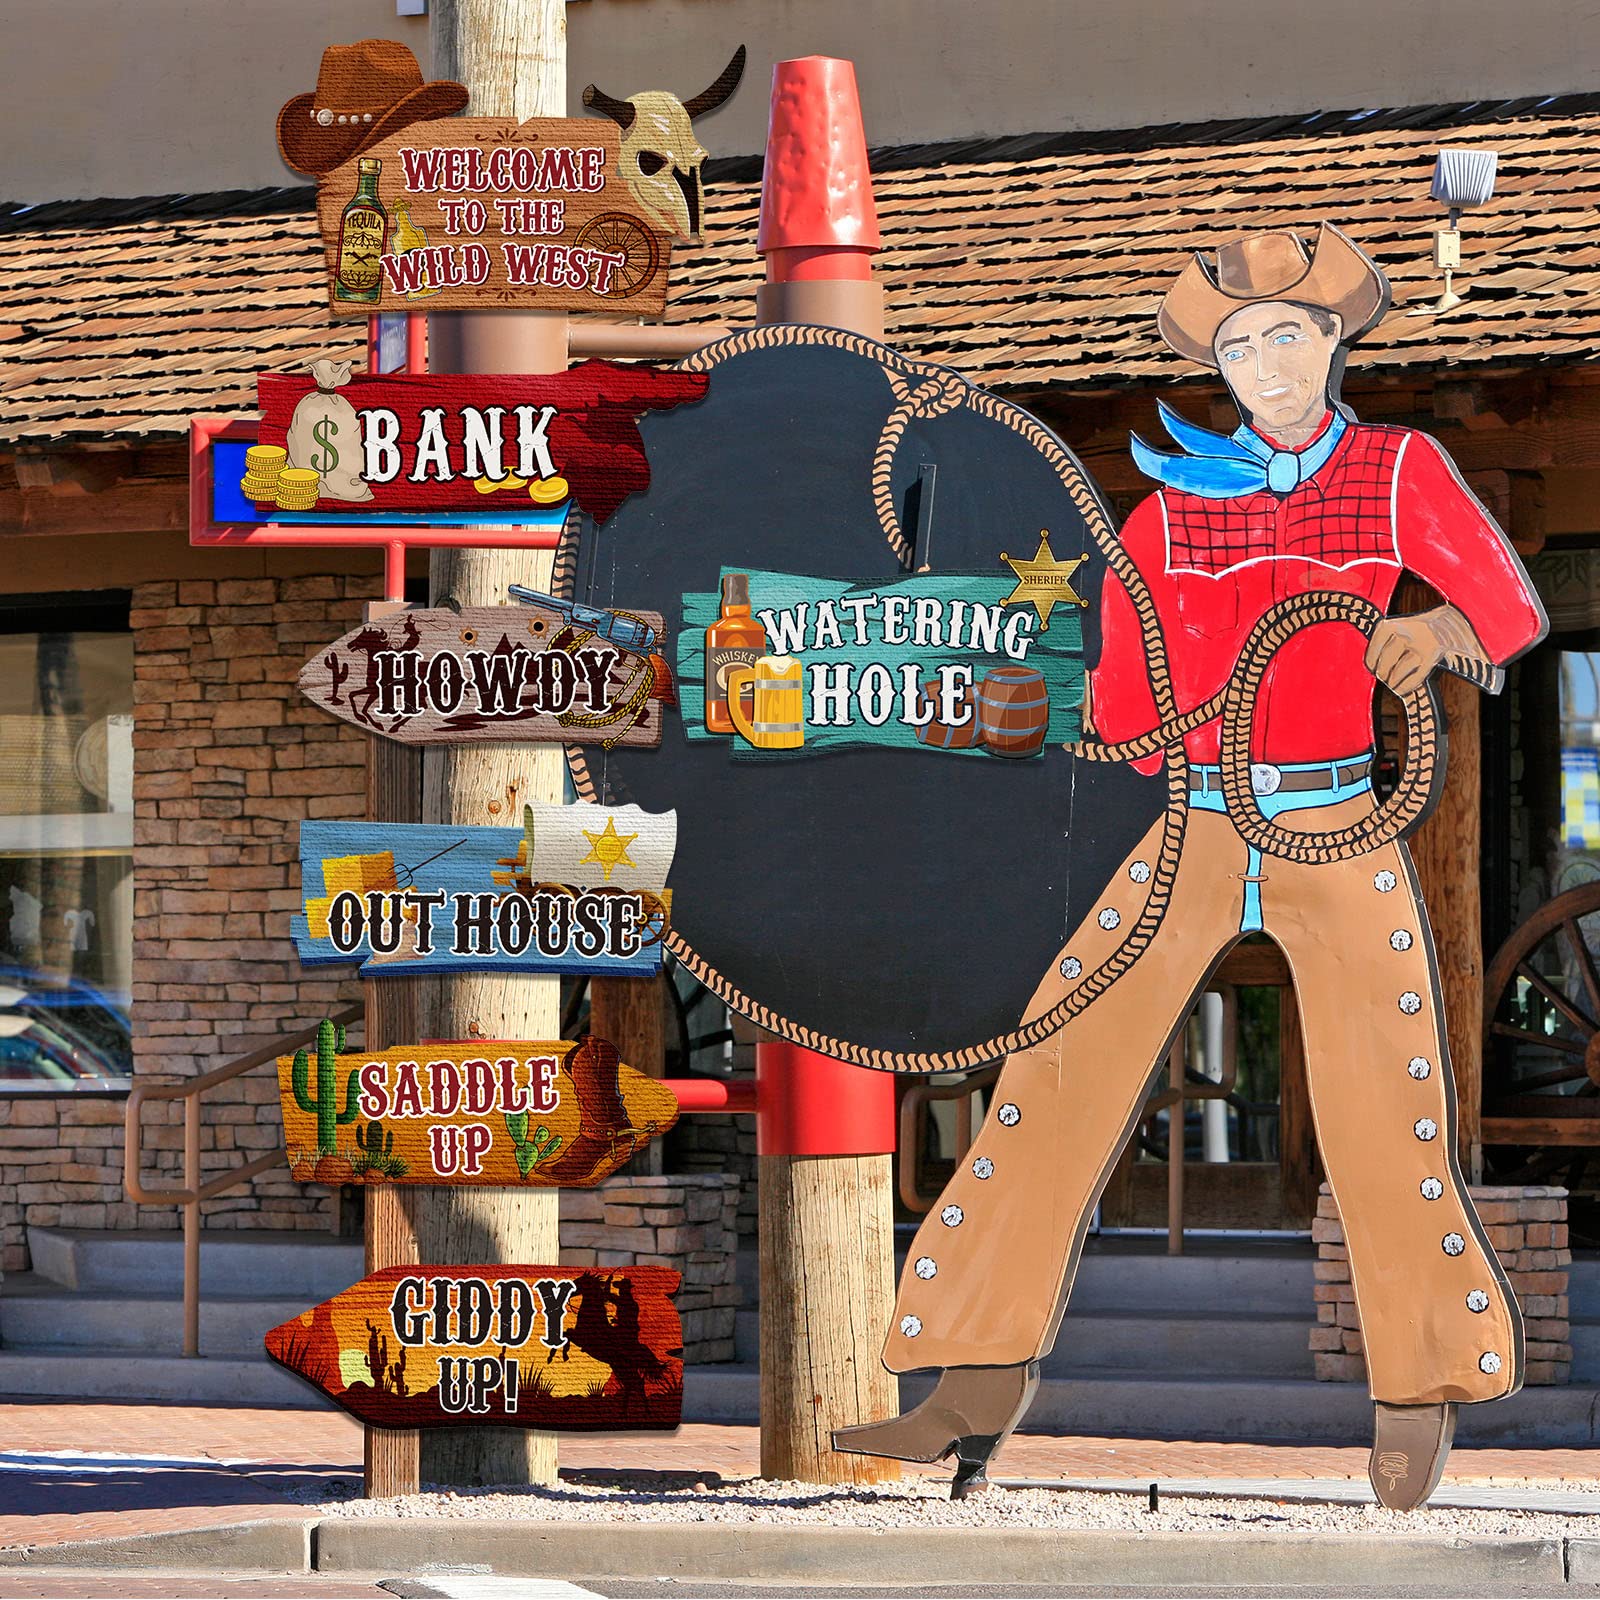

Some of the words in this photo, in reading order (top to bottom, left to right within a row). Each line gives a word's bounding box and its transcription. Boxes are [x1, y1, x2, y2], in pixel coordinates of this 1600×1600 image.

[400, 147, 606, 193] WELCOME
[347, 212, 382, 231] TEQUILA
[437, 198, 488, 235] TO
[495, 198, 565, 236] THE
[380, 244, 491, 294] WILD
[503, 243, 625, 294] WEST
[357, 407, 558, 483] BANK
[1023, 575, 1067, 585] SHERIFF
[757, 594, 1035, 660] WATERING
[373, 649, 619, 716] HOWDY
[806, 661, 974, 728] HOLE
[327, 888, 446, 954] OUT
[452, 890, 644, 959] HOUSE
[357, 1055, 560, 1120] SADDLE
[427, 1122, 492, 1175] UP
[389, 1276, 577, 1348] GIDDY
[437, 1356, 518, 1413] UP!
